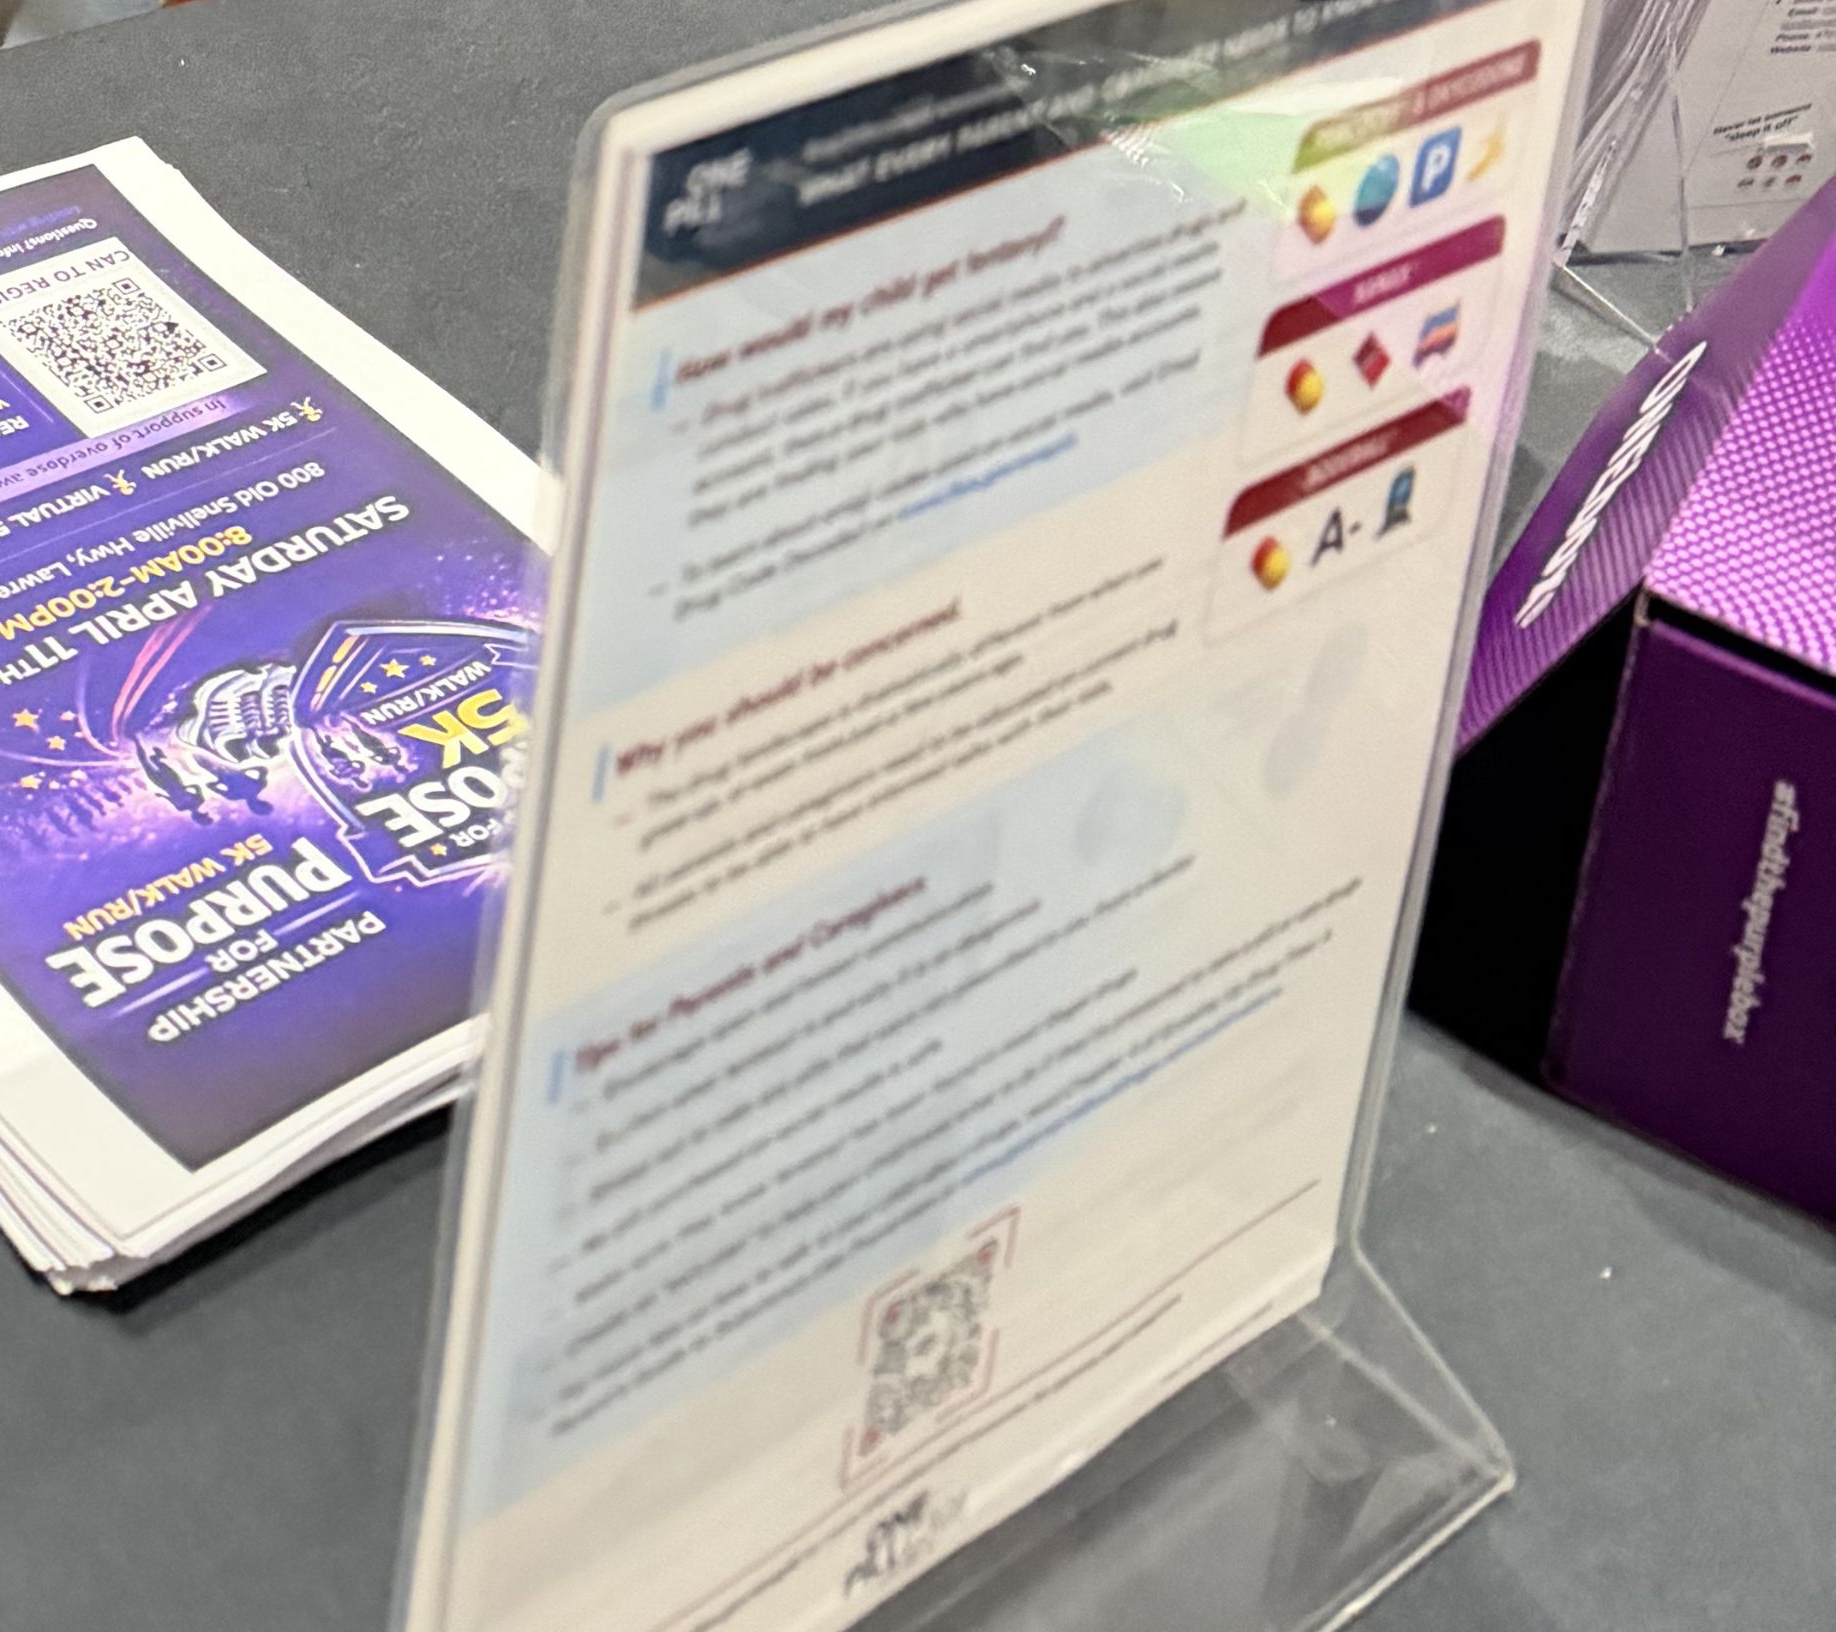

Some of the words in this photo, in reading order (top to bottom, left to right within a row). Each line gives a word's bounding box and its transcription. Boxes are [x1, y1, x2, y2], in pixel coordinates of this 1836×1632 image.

[23, 217, 97, 250] Questions?
[52, 265, 86, 282] TO
[84, 249, 130, 271] CAN
[203, 396, 227, 411] In
[261, 410, 298, 432] 5K
[122, 406, 203, 439] support
[24, 441, 108, 477] overdose
[111, 433, 131, 450] of
[140, 424, 268, 479] WALK/RUN
[276, 461, 325, 488] 800
[6, 484, 111, 527] VIRTUAL
[233, 480, 279, 507] Old
[131, 495, 238, 542] Snellville
[65, 536, 135, 567] Hwy,
[204, 495, 409, 597] SATURDAY
[67, 579, 197, 644] APRIL
[359, 660, 492, 725] WALK/RUN
[393, 705, 526, 772] 5K
[219, 832, 273, 866] 5K
[448, 817, 510, 847] FOR
[62, 856, 226, 941] WALK/RUN
[44, 836, 352, 1007] PURPOSE
[204, 928, 278, 972] FOR
[147, 910, 386, 1041] PARTNERSHIP
